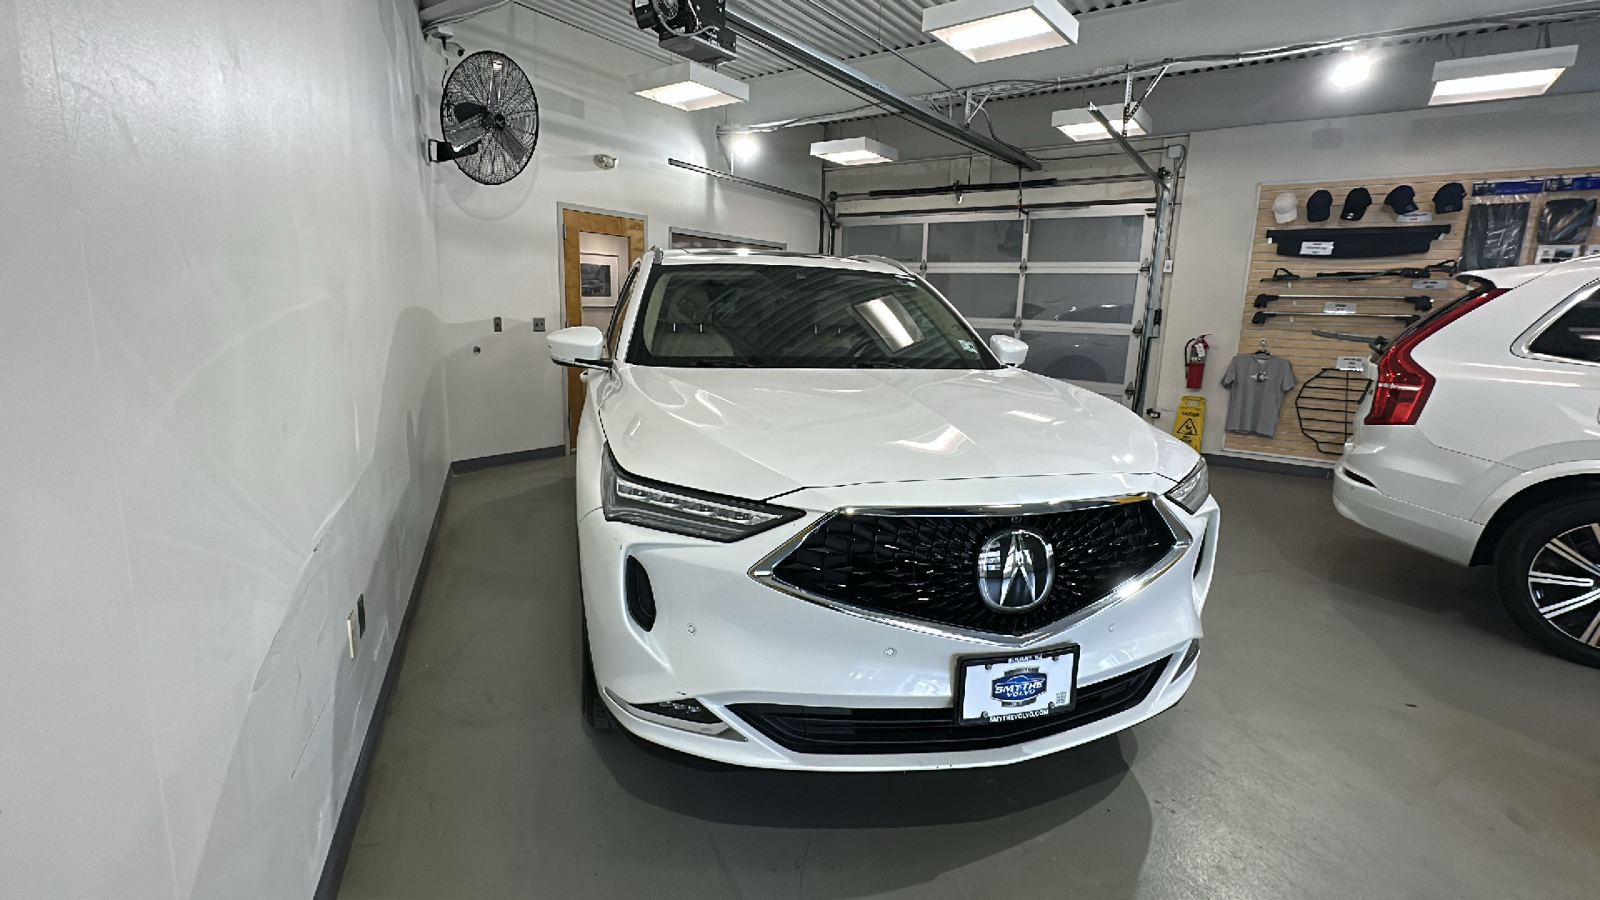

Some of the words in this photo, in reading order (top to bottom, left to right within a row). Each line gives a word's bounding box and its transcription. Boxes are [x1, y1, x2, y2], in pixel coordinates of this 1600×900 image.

[995, 682, 1042, 693] SMYTHE
[1006, 689, 1036, 697] VOLVO
[989, 709, 1048, 722] SMYTHEVOLVO.COM
